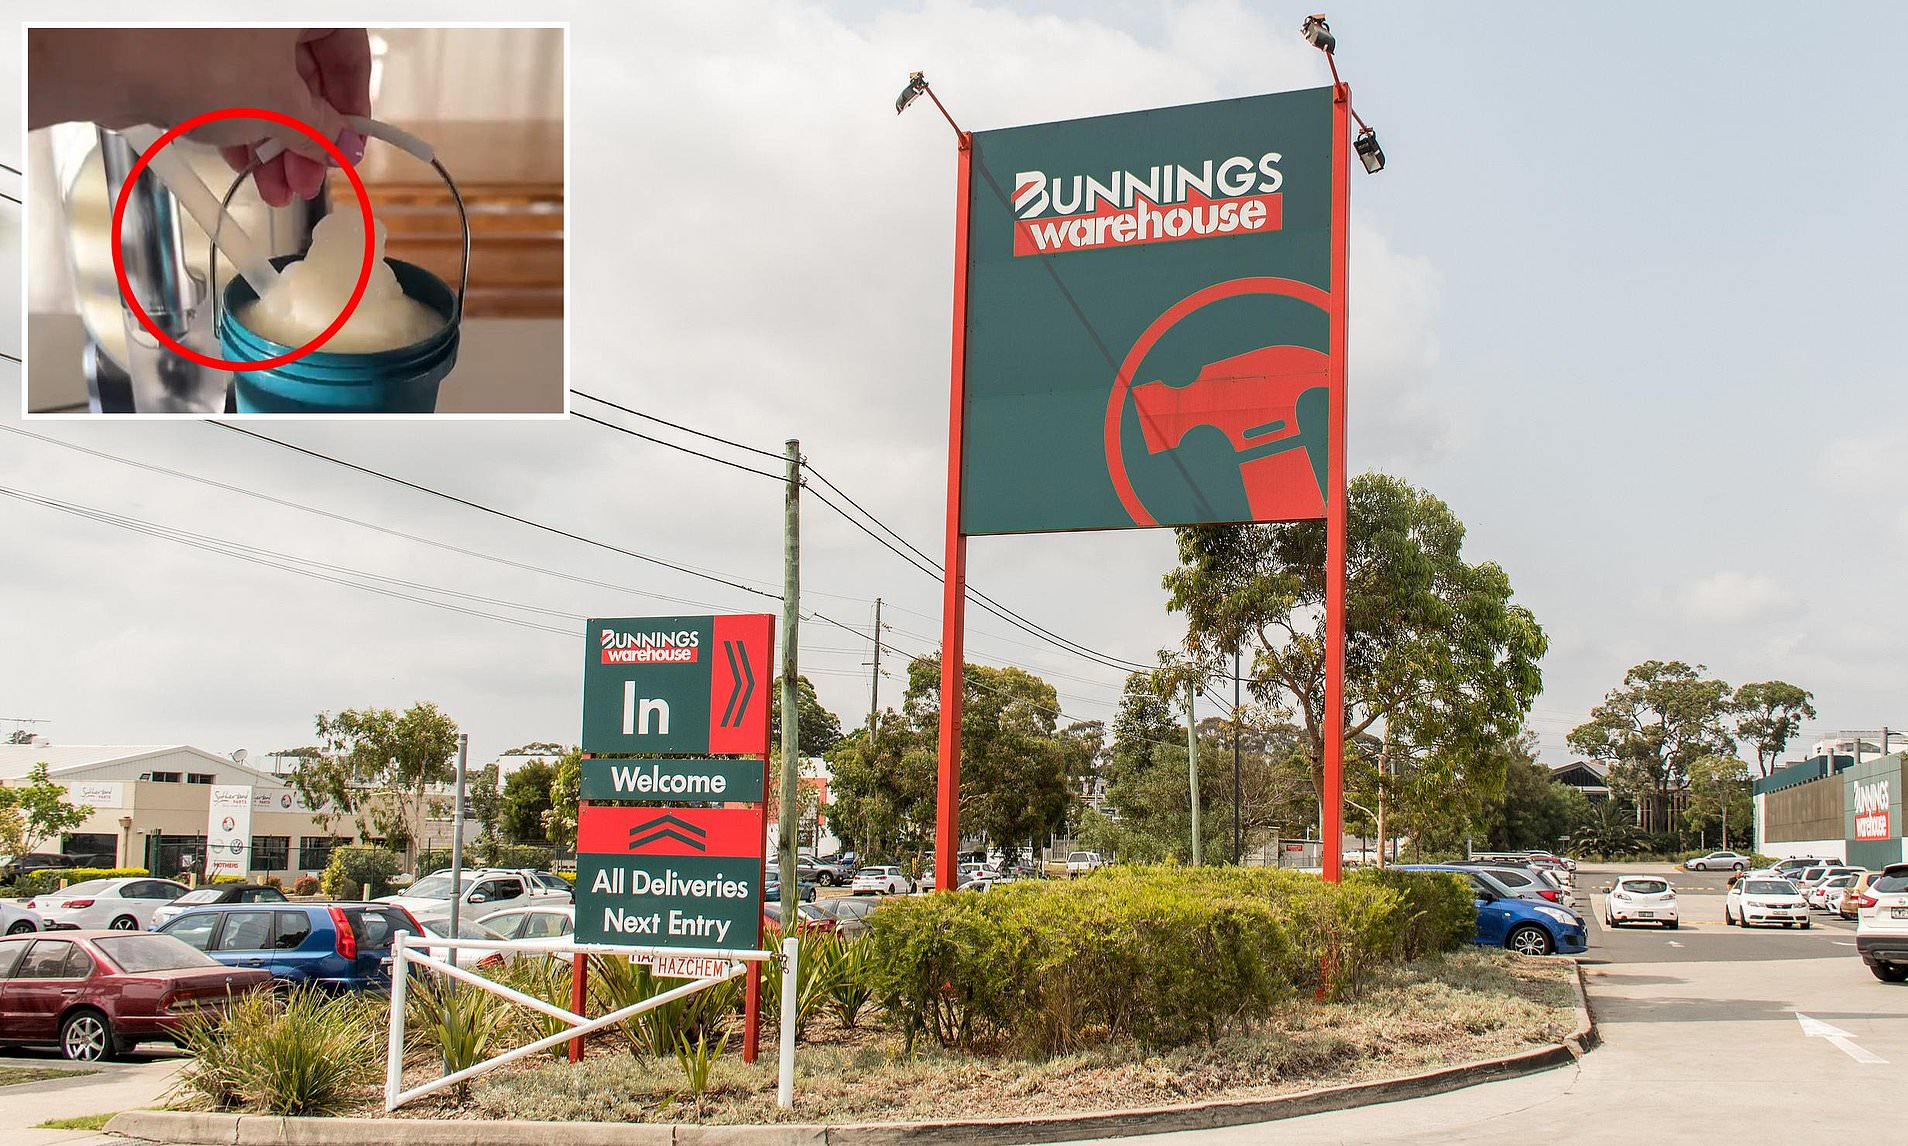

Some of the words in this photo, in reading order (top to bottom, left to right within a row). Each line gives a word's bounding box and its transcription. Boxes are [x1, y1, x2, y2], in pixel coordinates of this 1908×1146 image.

[1013, 152, 1283, 219] BUNNINGS
[1029, 198, 1268, 250] warehouse
[601, 629, 699, 650] BUNNINGS
[608, 644, 692, 662] warehouse
[623, 680, 670, 735] In
[611, 765, 727, 795] Welcome
[1854, 780, 1889, 813] BUNNINGS
[1856, 810, 1887, 838] warehouse
[591, 867, 625, 895] All
[632, 868, 749, 899] Deliveries
[603, 907, 661, 934] Next
[668, 909, 732, 943] Entry
[658, 957, 724, 977] HAZCHEM
